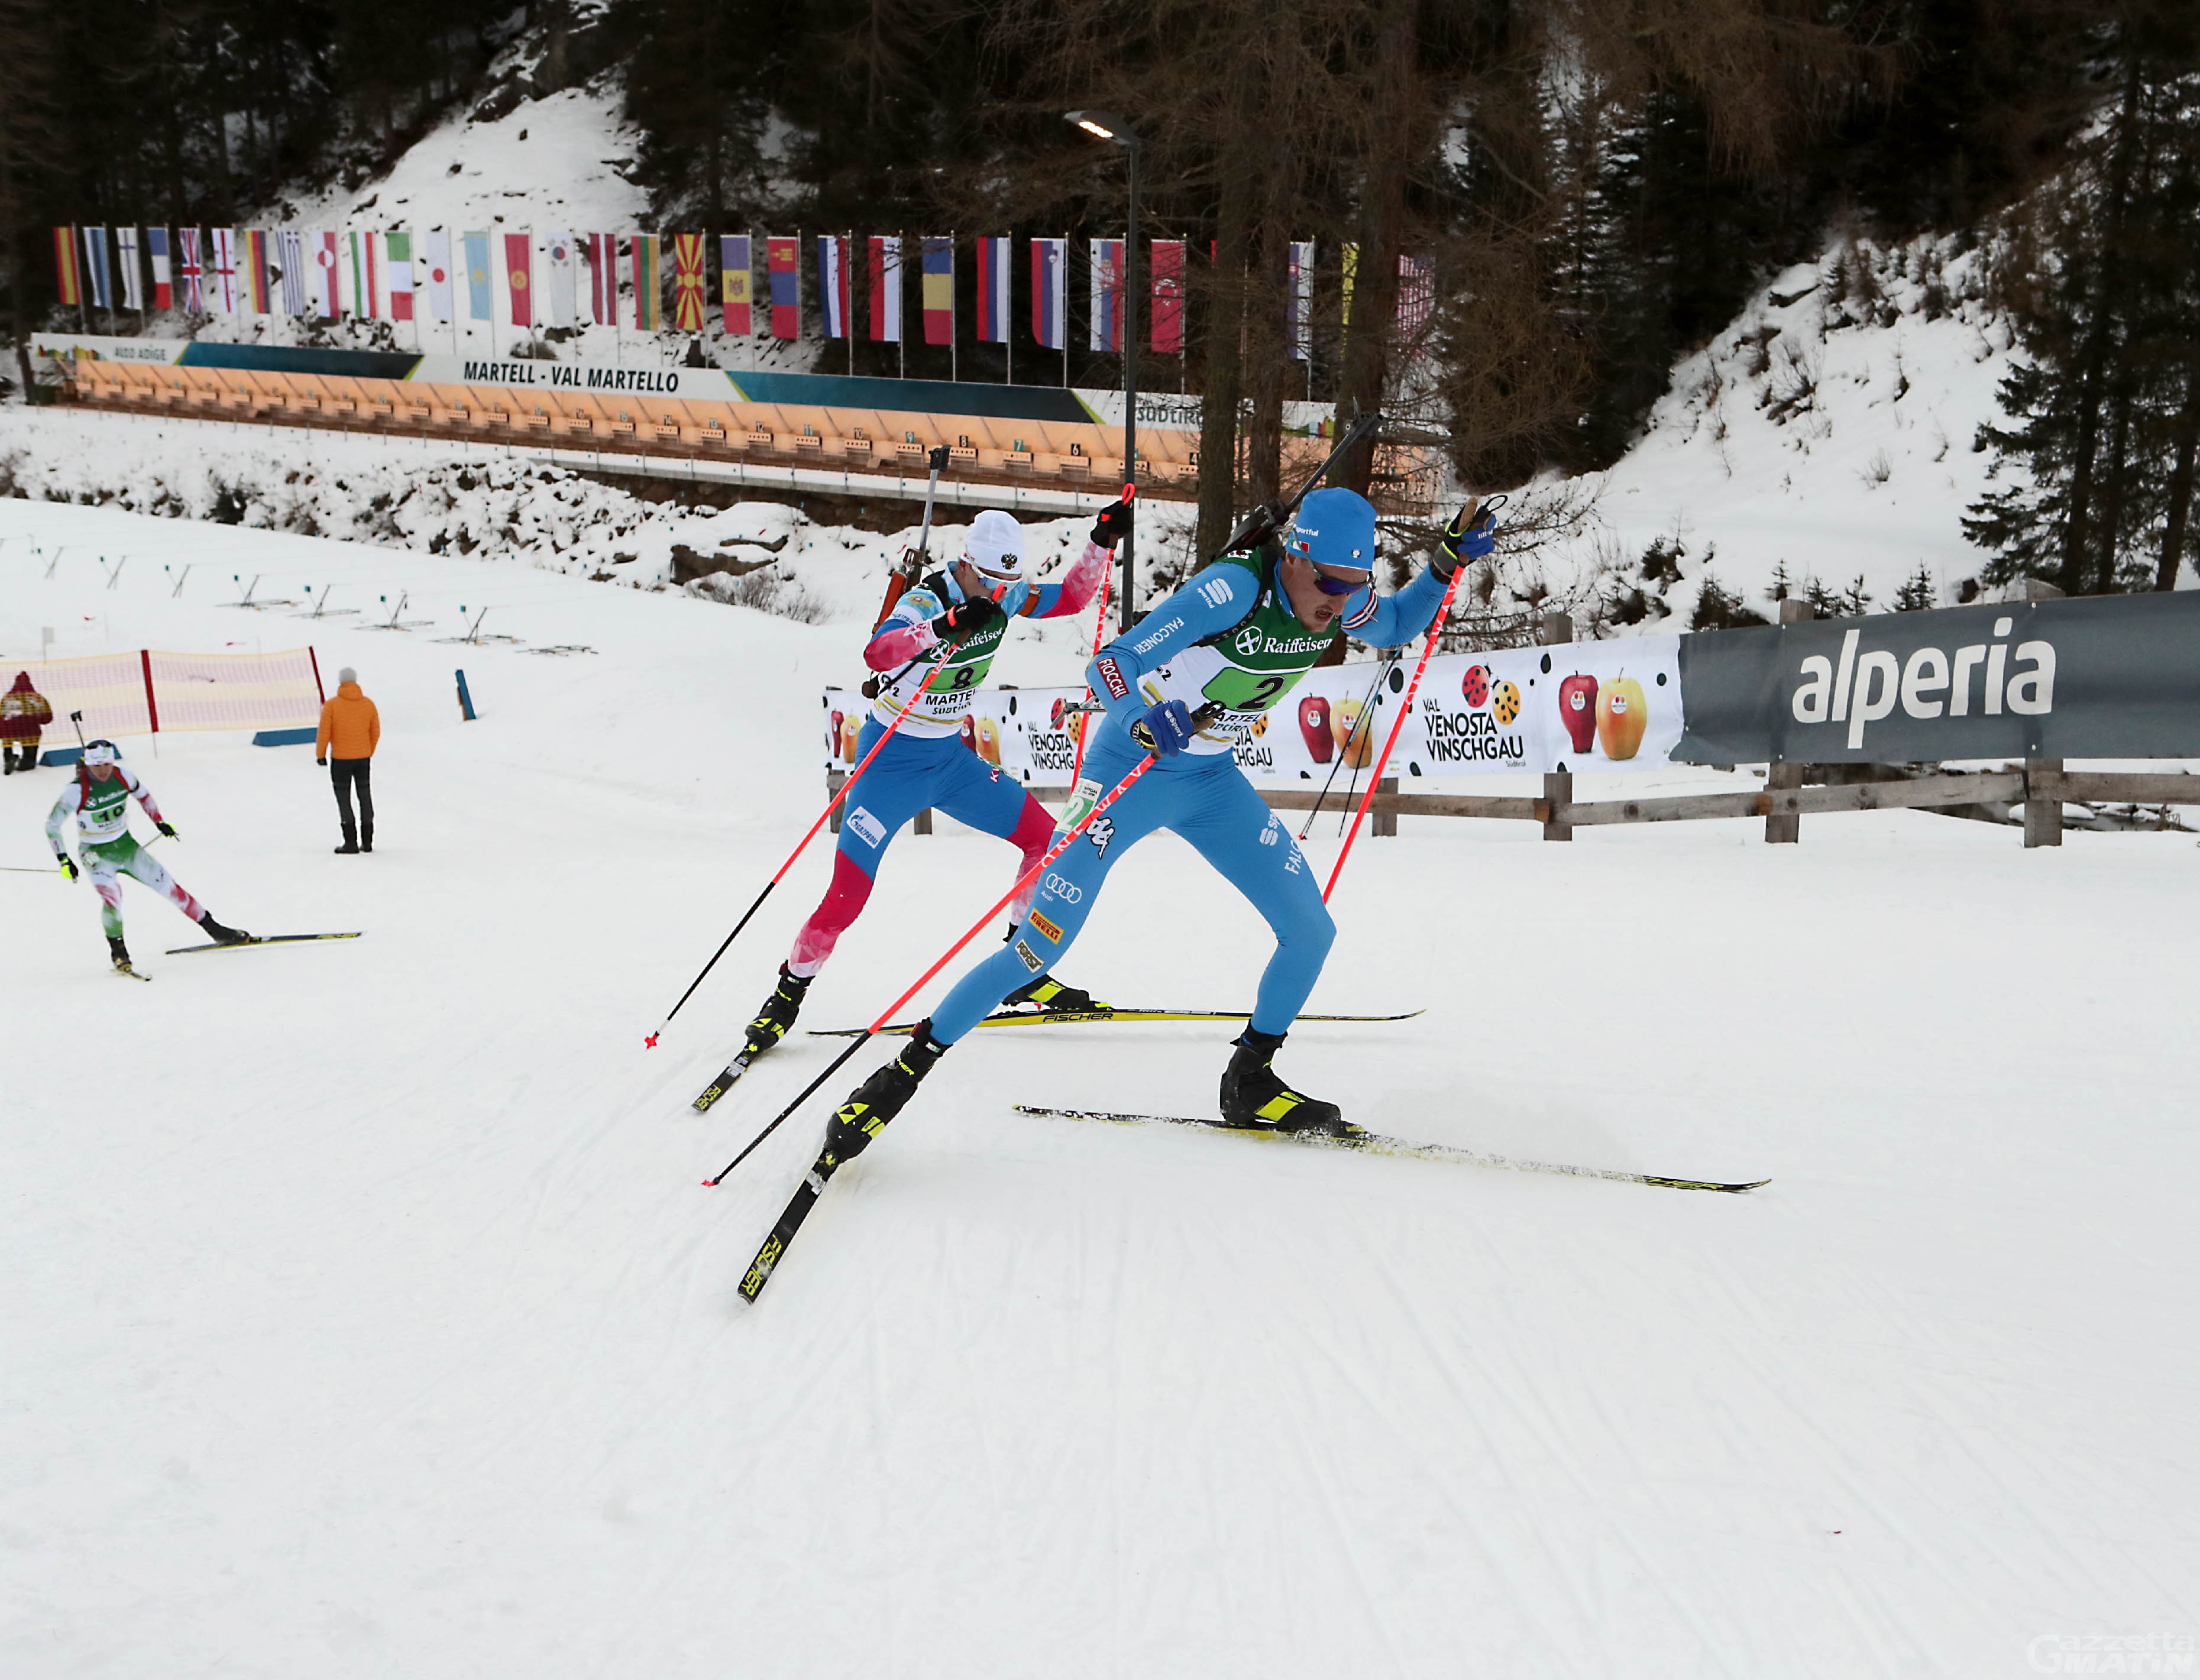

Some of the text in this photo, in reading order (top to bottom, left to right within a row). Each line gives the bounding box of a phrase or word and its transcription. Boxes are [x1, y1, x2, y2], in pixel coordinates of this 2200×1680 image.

[464, 361, 535, 383] MARTELL
[552, 367, 581, 386] VAL
[587, 368, 679, 393] MARTELLO
[907, 432, 914, 442] 9
[960, 436, 966, 446] 8
[1015, 441, 1023, 451] 7
[1072, 444, 1079, 456] 6
[1296, 526, 1319, 537] sportful
[1196, 586, 1215, 610] sportful
[1133, 617, 1185, 654] FALCONERI
[1263, 636, 1333, 653] Raiffeisen
[950, 666, 975, 691] 8
[1098, 658, 1127, 698] FIOCCHI
[1161, 669, 1172, 682] 2
[1792, 617, 2057, 749] alperia
[892, 687, 900, 697] 2
[1234, 675, 1286, 710] 2
[1423, 698, 1440, 712] VAL
[1215, 711, 1261, 722] ARTEL
[1425, 713, 1497, 737] VENOSTA
[1028, 721, 1037, 732] VAL
[1028, 733, 1073, 751] VENOSTA
[1426, 736, 1524, 762] VINSCHGAU
[1058, 796, 1085, 831] 2
[1040, 890, 1054, 902] Audi
[1031, 911, 1060, 940] PIRELLI
[1017, 941, 1043, 970] FORST
[1042, 1012, 1114, 1022] FISCHER
[741, 1234, 782, 1296] FISCHER
